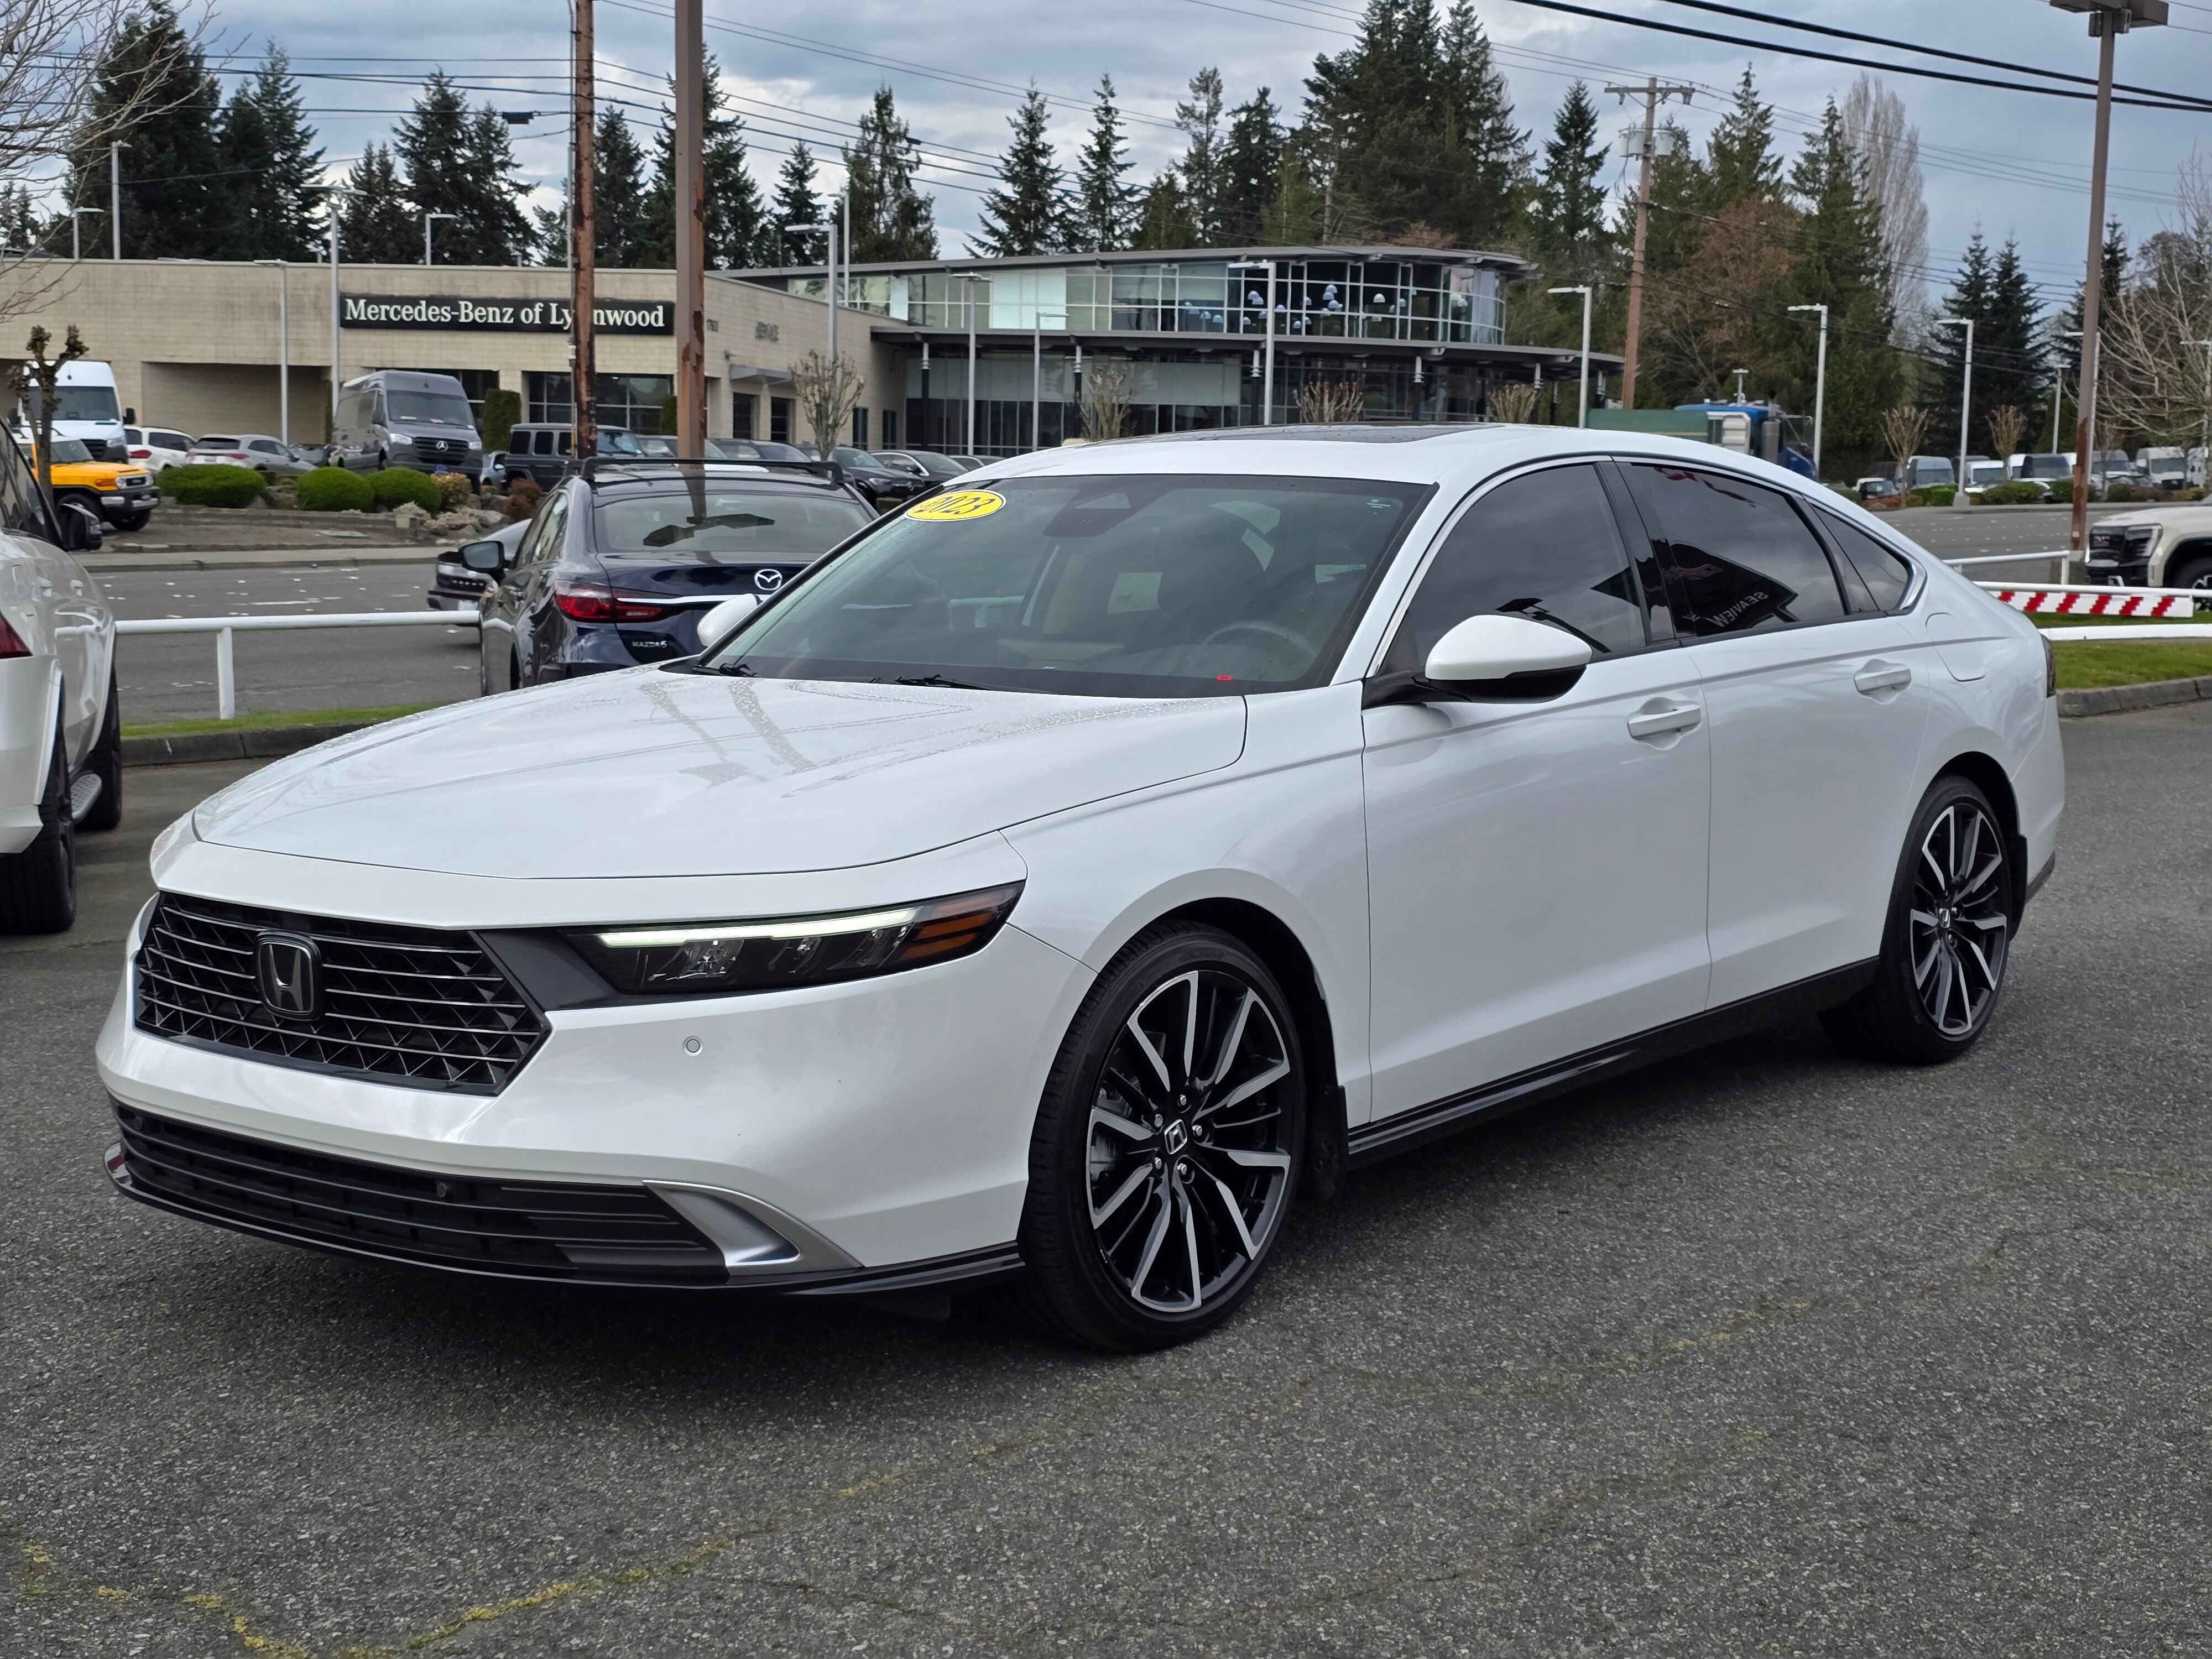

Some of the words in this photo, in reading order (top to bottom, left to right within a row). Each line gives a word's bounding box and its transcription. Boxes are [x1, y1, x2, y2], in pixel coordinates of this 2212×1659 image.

[345, 299, 514, 324] Mercedes-Benz
[520, 302, 544, 325] of
[550, 302, 665, 330] Lynwood
[914, 495, 996, 515] 2023
